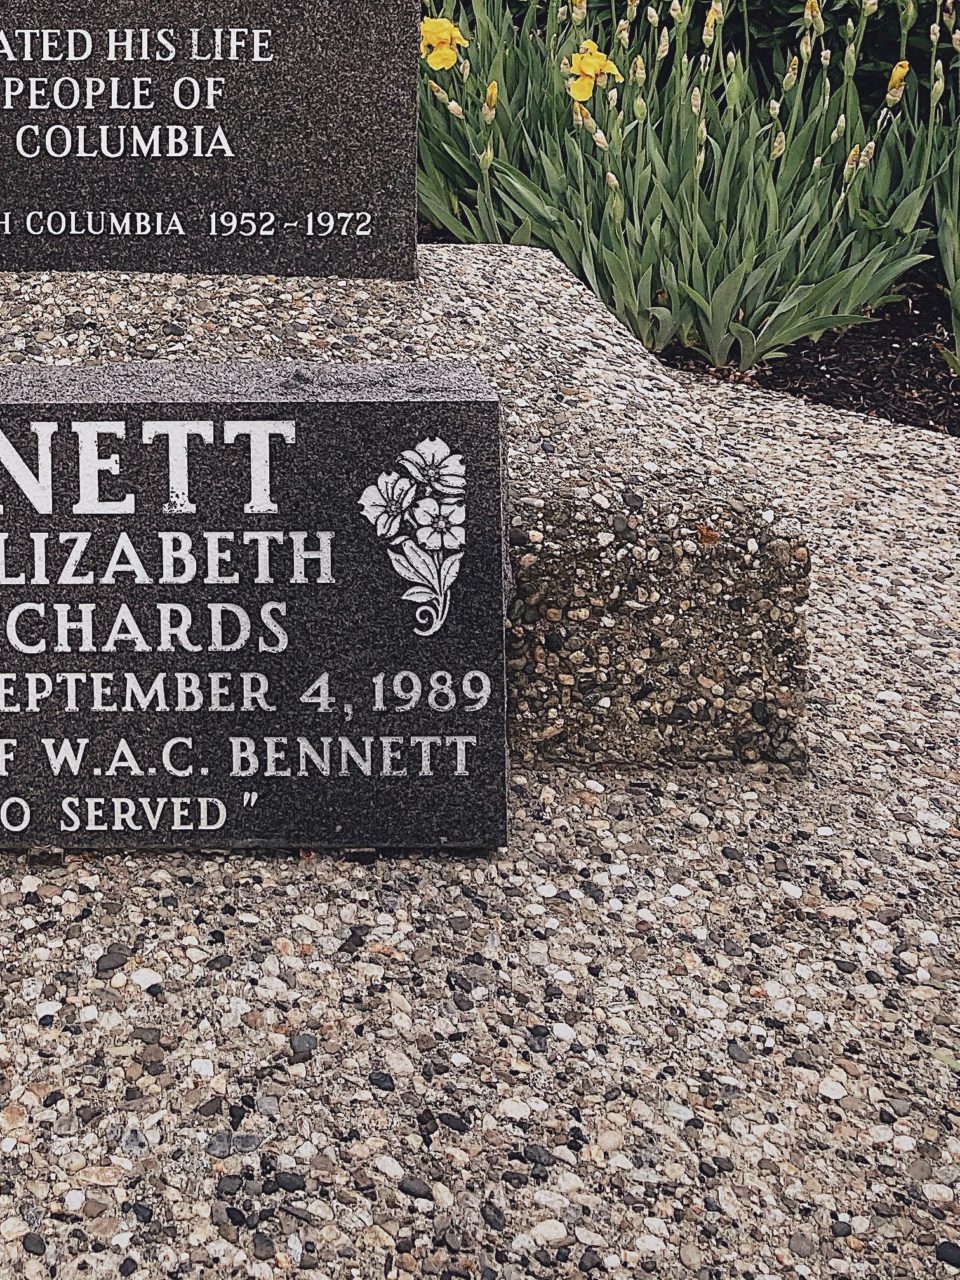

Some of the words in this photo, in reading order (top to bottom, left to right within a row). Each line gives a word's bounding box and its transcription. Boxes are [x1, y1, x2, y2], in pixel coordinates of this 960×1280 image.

[108, 29, 176, 61] HIS
[191, 28, 273, 62] LIFE
[4, 77, 153, 110] PEOPLE
[173, 76, 225, 109] OF
[16, 124, 234, 158] COLUMBIA
[26, 211, 185, 235] COLUMBIA
[300, 673, 355, 721] 4,
[372, 671, 491, 711] 1989
[42, 738, 209, 776] W.A.C.
[229, 737, 476, 777] BENNETT
